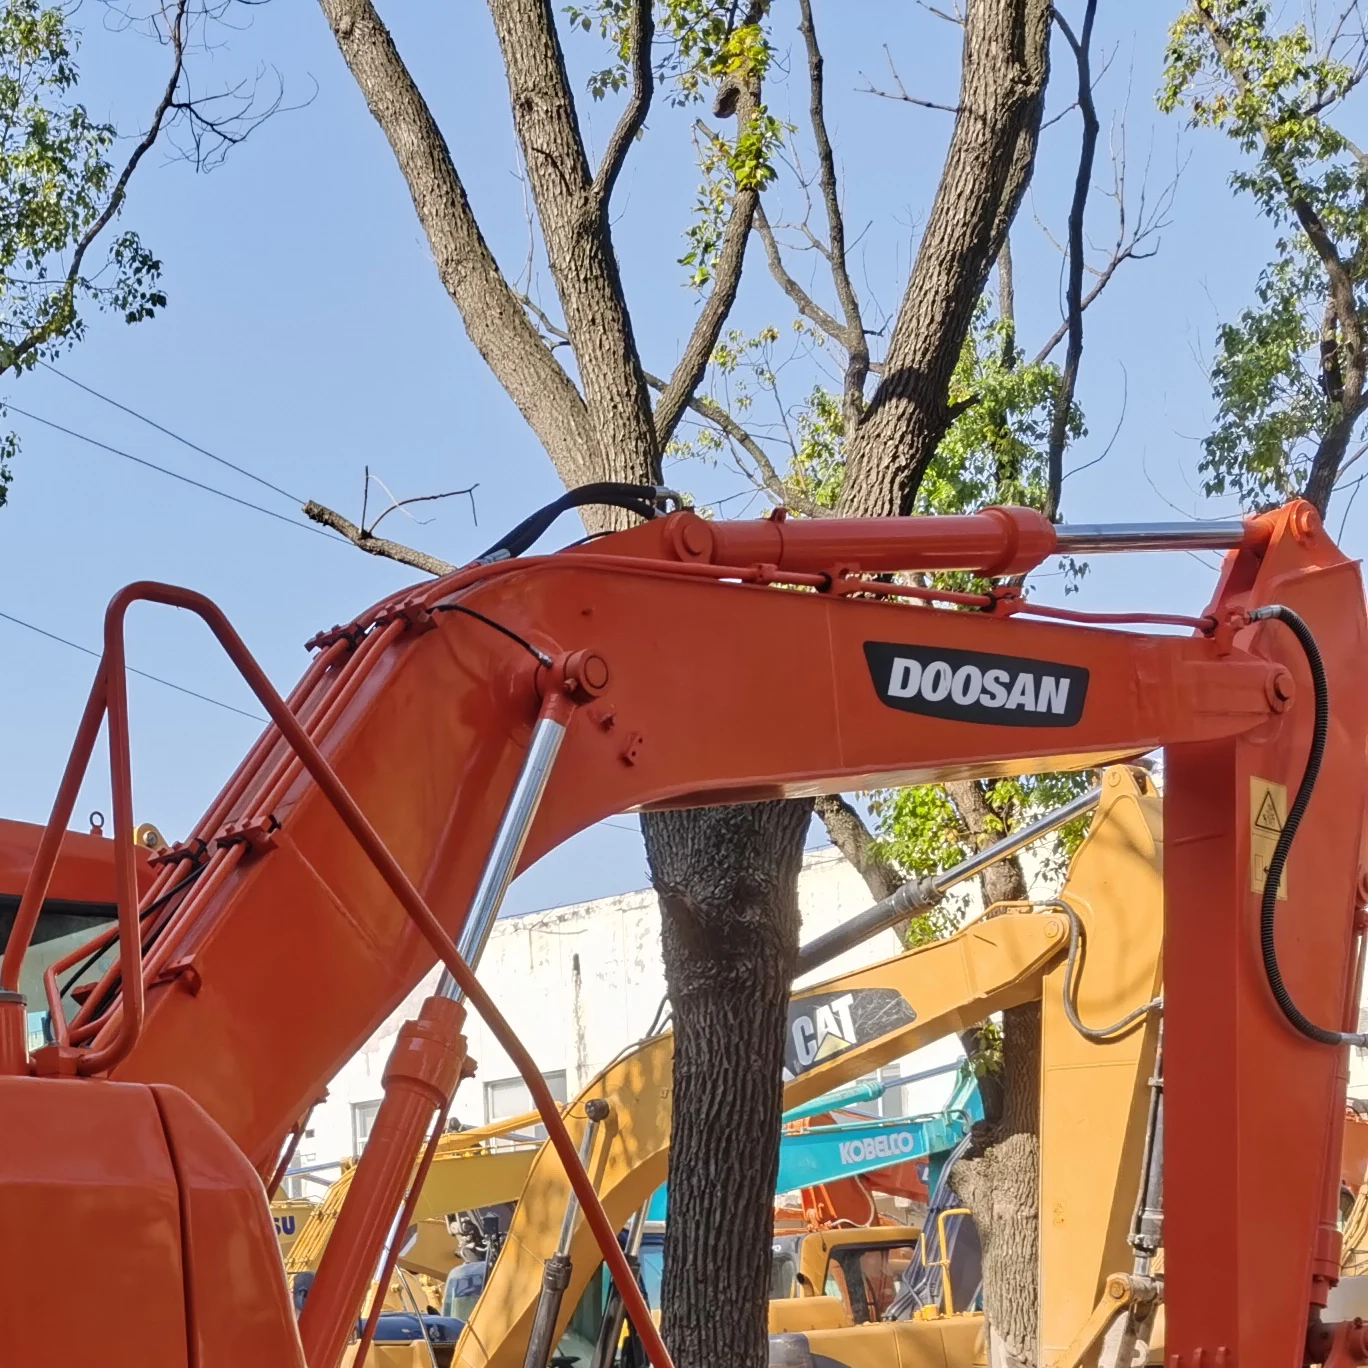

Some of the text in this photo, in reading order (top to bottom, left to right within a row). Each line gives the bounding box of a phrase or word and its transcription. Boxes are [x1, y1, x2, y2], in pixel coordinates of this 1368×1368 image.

[887, 657, 1071, 715] DOOSAN
[792, 993, 857, 1066] CAT
[839, 1131, 914, 1165] KOBELCO
